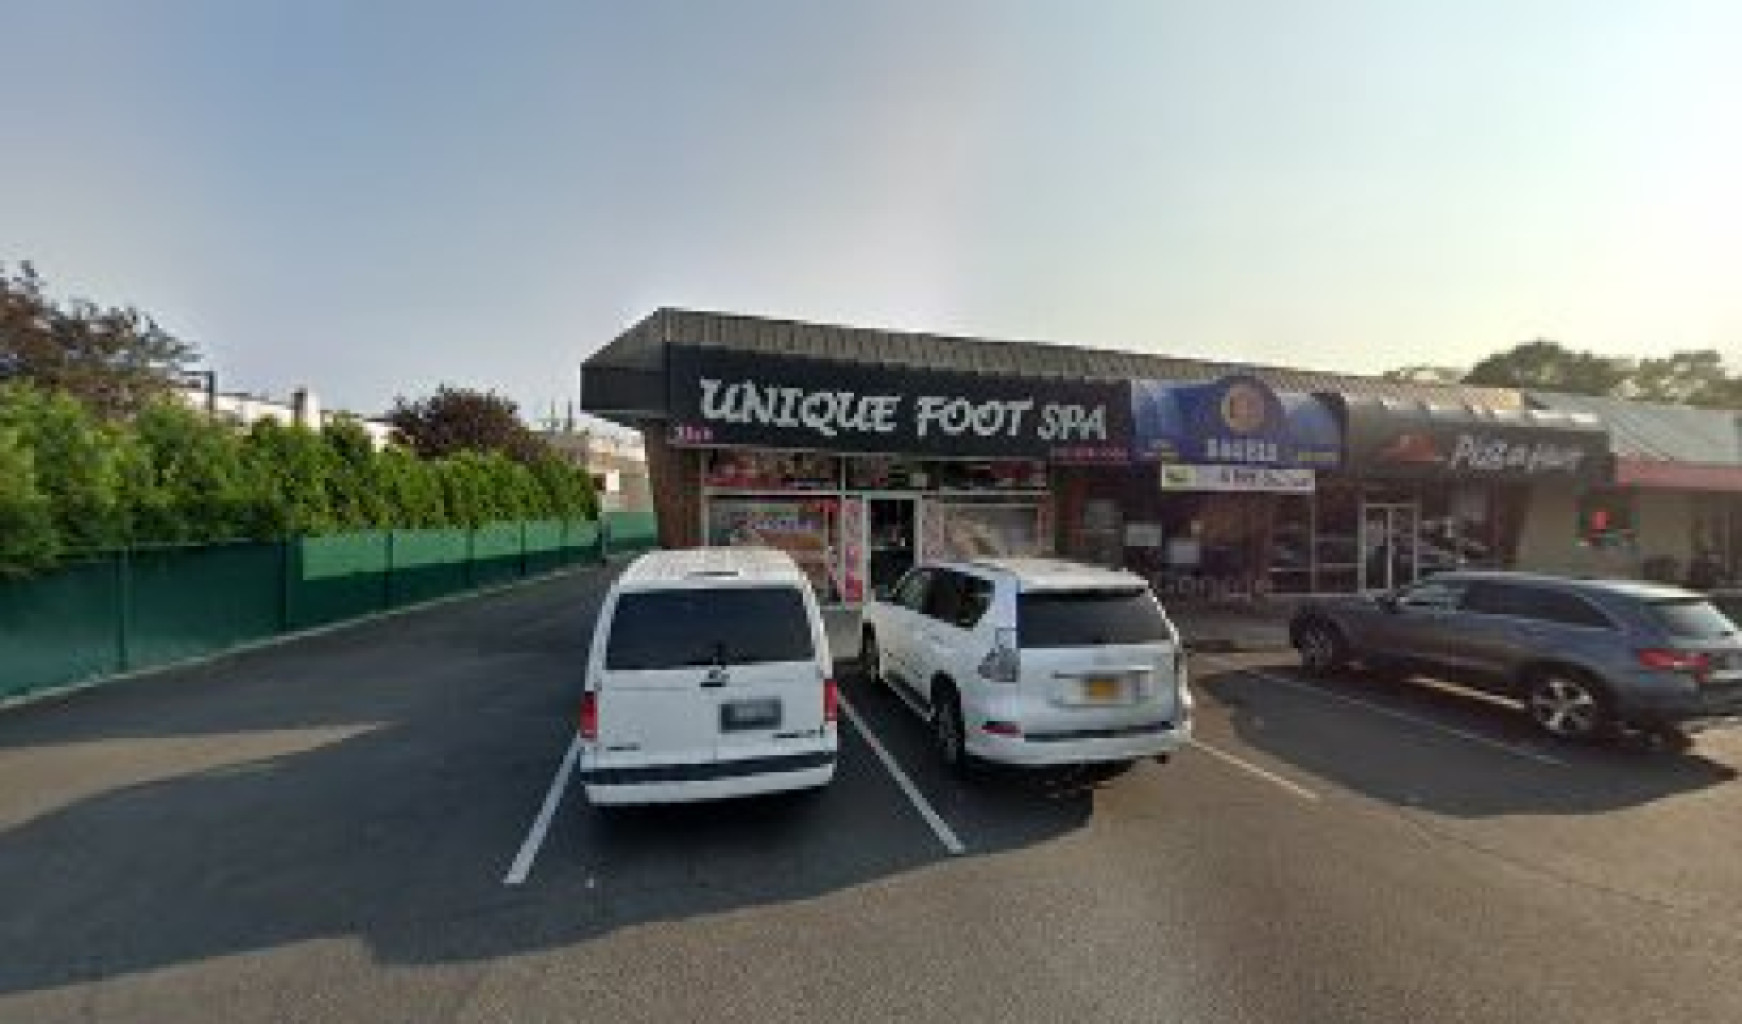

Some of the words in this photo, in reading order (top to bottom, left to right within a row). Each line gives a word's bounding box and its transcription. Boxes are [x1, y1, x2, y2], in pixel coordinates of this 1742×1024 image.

[700, 378, 902, 436] UNIQUE
[916, 396, 1034, 437] FOOT
[1038, 403, 1107, 440] SPA
